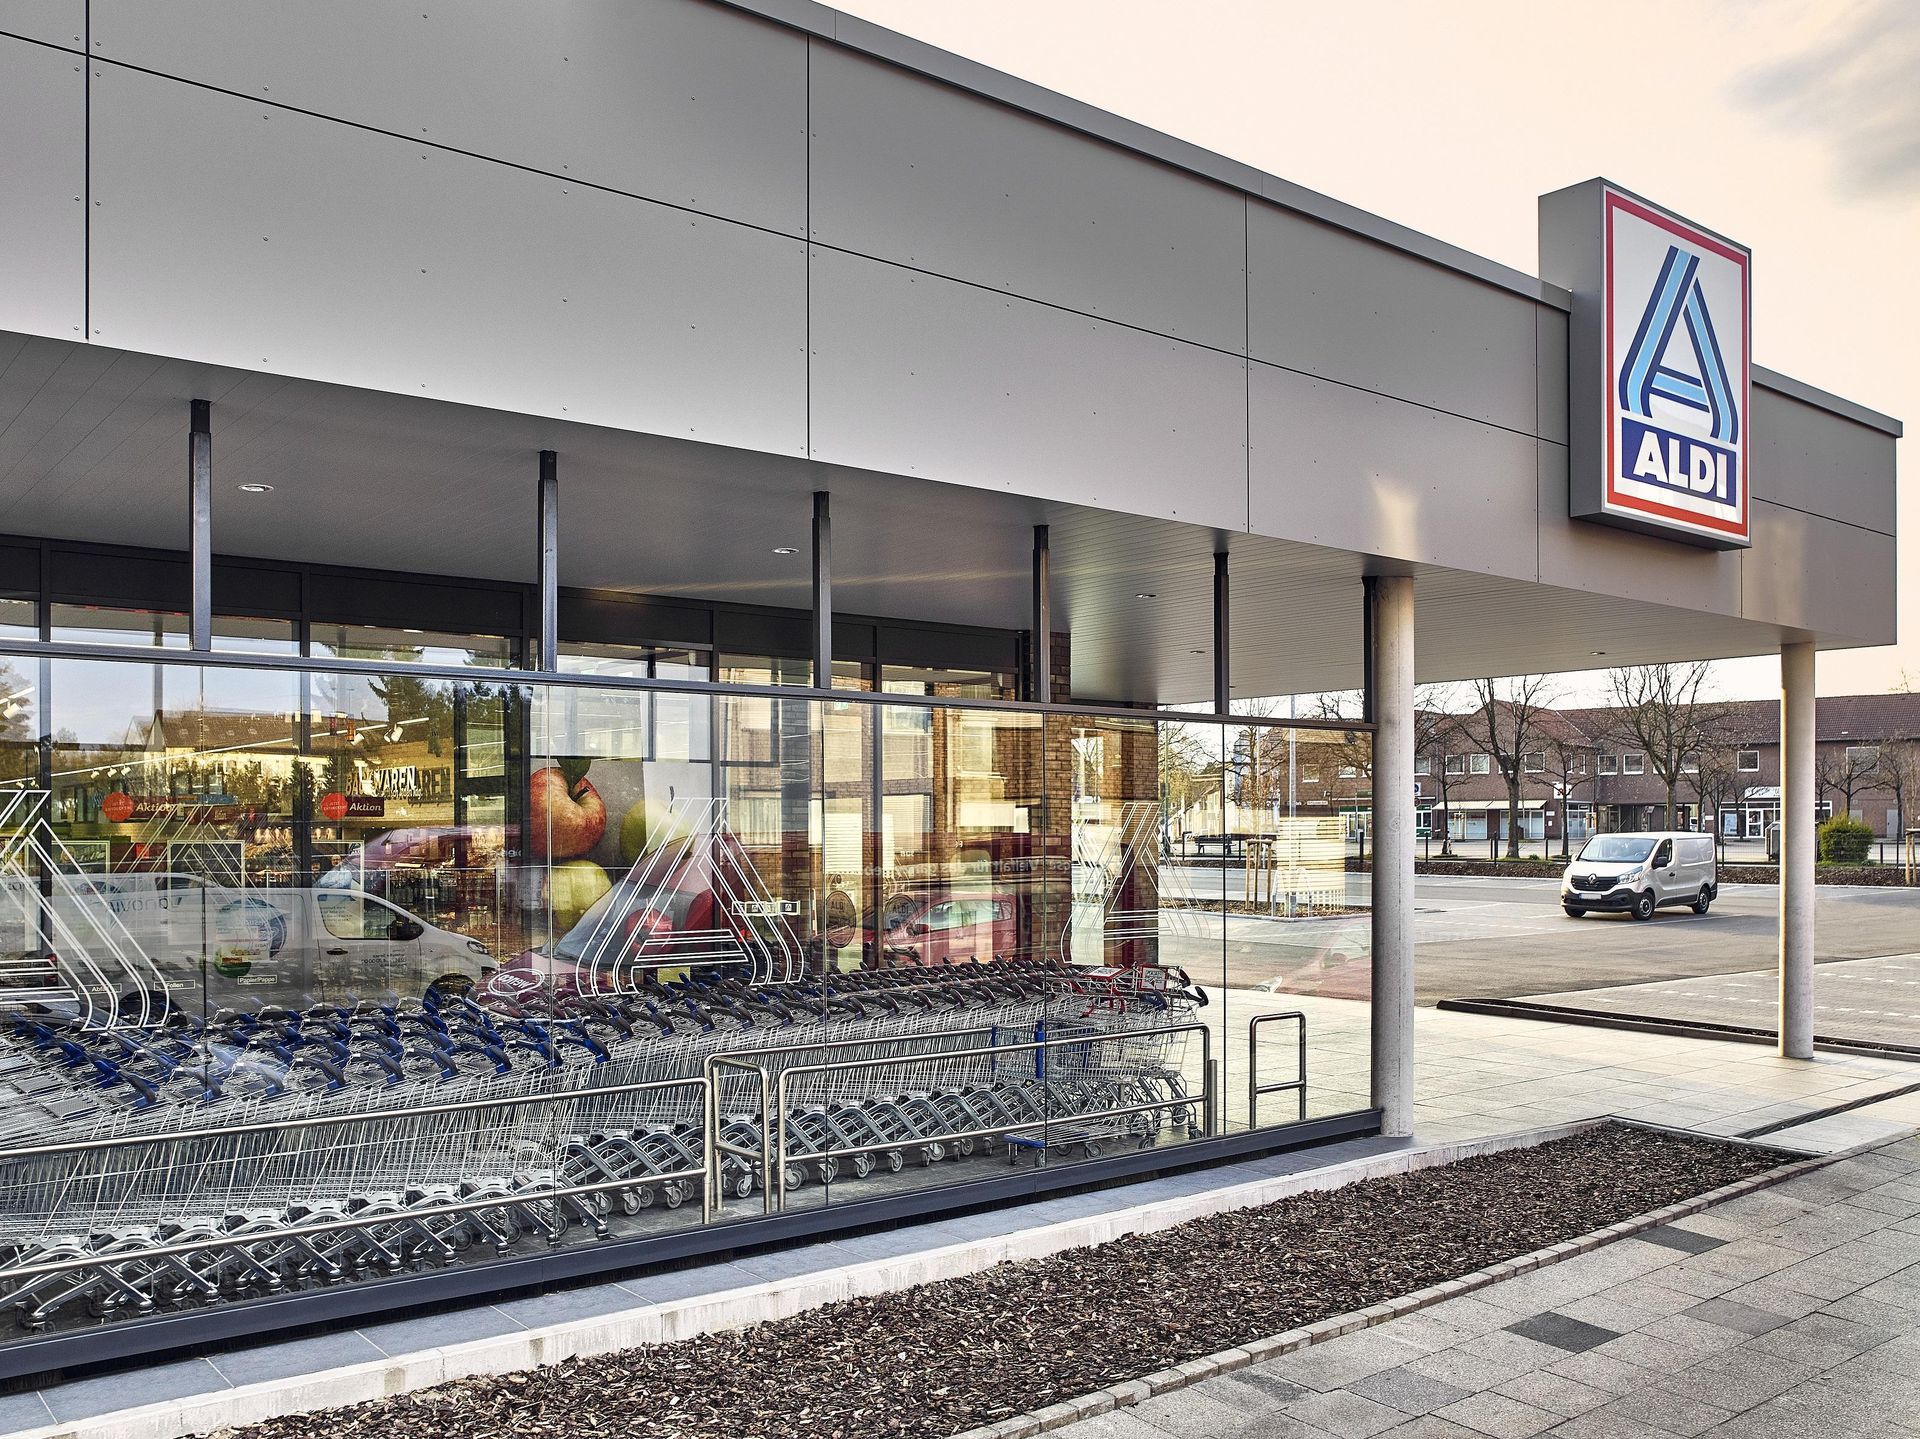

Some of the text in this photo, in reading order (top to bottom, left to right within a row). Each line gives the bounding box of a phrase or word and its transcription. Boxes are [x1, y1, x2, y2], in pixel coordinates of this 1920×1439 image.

[1633, 431, 1728, 500] ALDI
[349, 802, 382, 812] Aktion
[892, 905, 909, 914] ALDI
